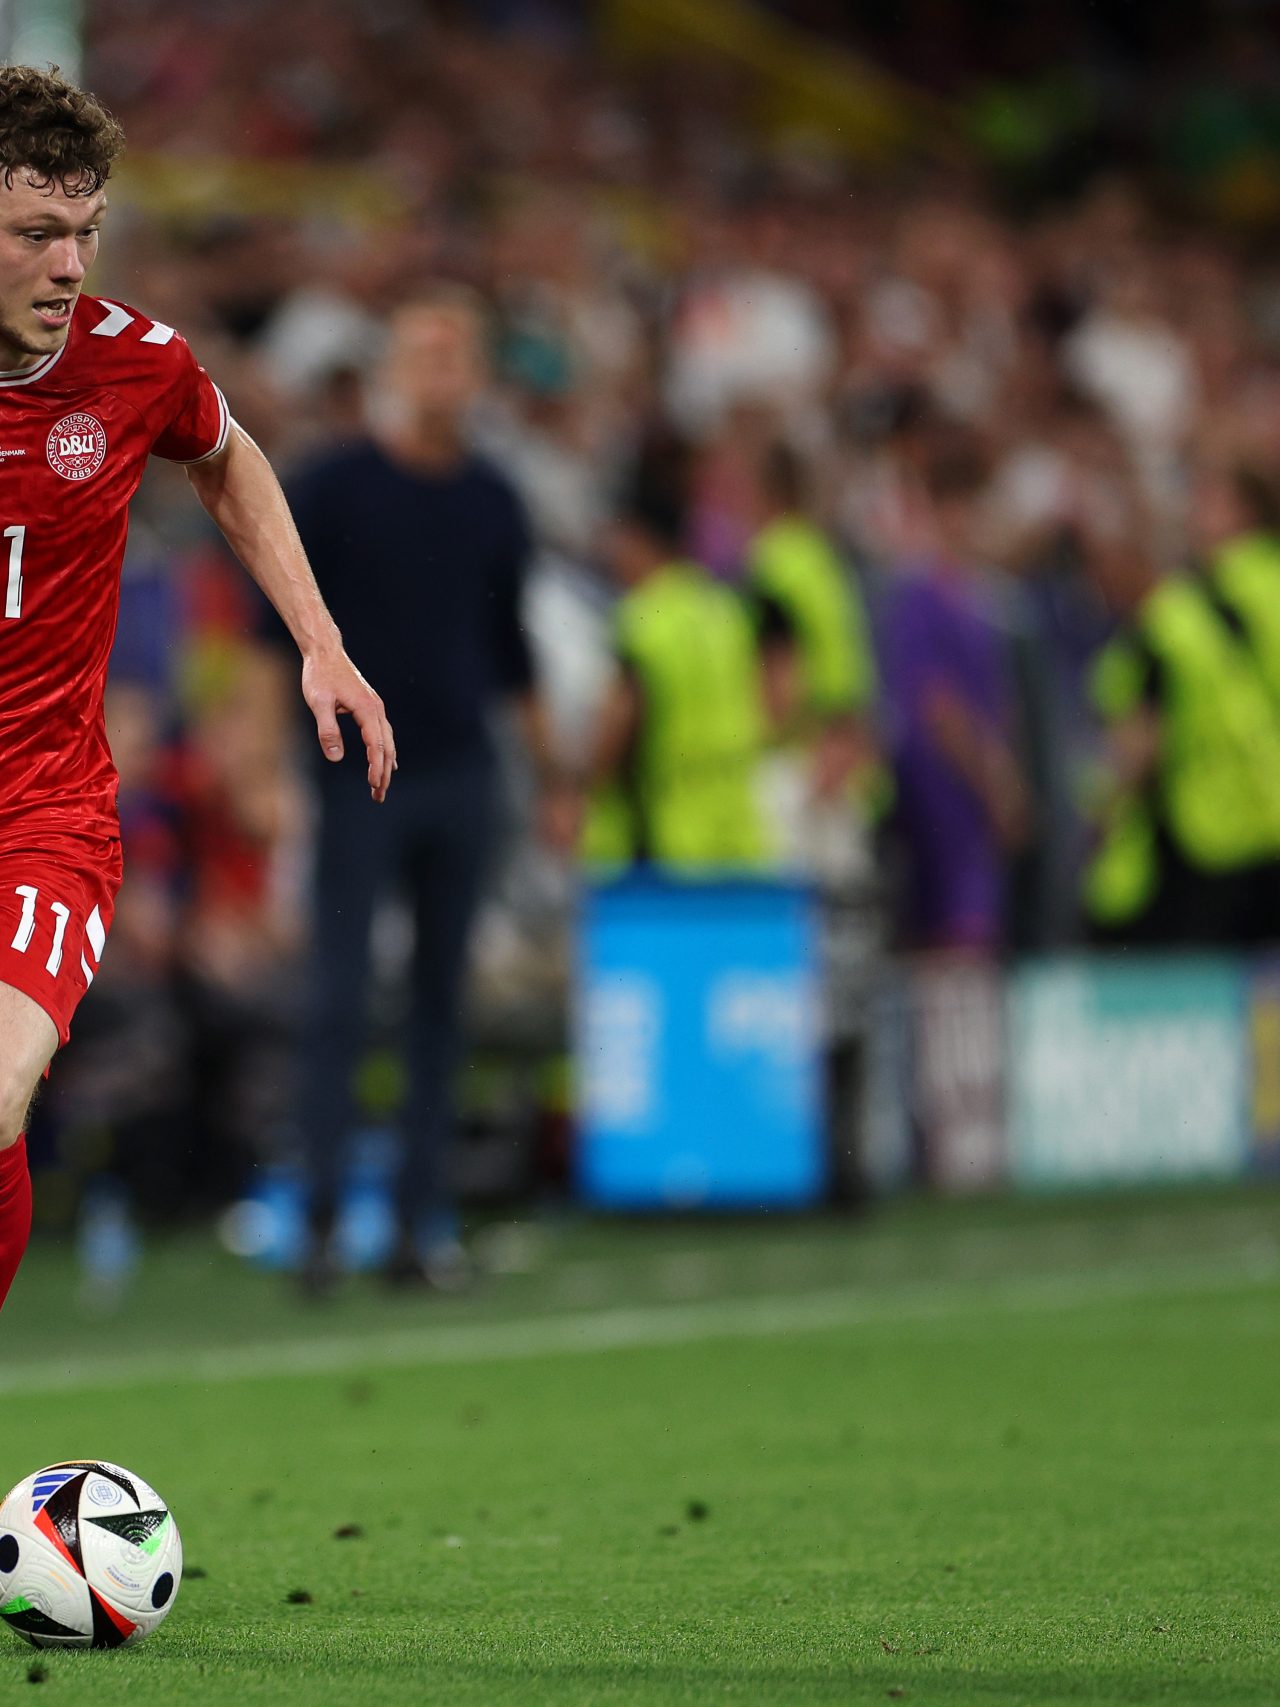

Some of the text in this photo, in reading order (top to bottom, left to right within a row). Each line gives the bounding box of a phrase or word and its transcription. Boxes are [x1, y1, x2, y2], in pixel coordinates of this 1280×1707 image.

[49, 435, 65, 473] DANSK
[92, 431, 105, 467] UNION
[59, 434, 95, 456] DBU
[67, 467, 91, 478] 1889
[10, 884, 71, 978] 11
